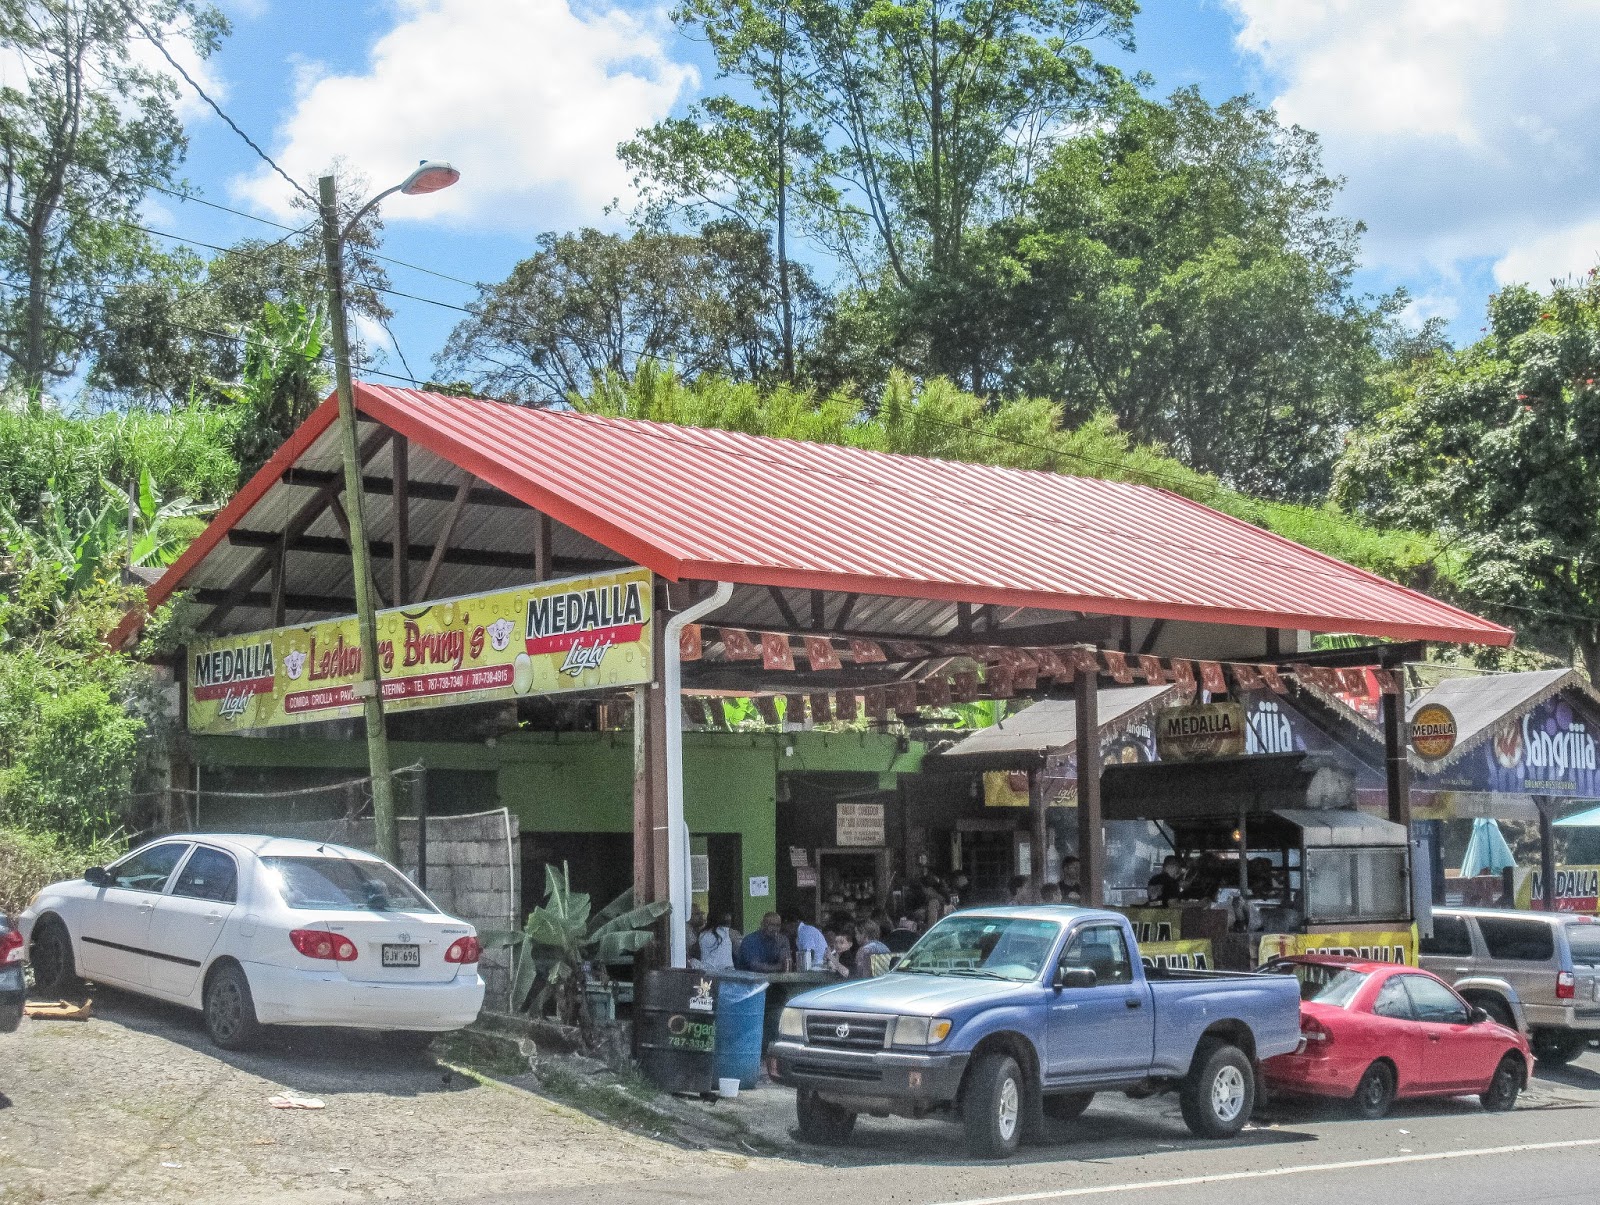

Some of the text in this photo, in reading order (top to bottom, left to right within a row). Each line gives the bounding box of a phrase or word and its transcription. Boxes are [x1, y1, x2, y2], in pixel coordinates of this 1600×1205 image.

[525, 581, 643, 640] MEDALLA
[403, 611, 485, 671] Bruny's
[194, 642, 275, 688] MEDALLA
[559, 638, 613, 677] Light
[218, 688, 255, 720] Light
[311, 692, 333, 706] CRIOLLA
[381, 682, 406, 696] ATERING
[413, 680, 425, 692] TEL
[1167, 713, 1233, 736] MEDALLA
[1411, 722, 1456, 737] MEDALLA
[1531, 869, 1599, 901] MDALLA
[403, 951, 418, 962] 696
